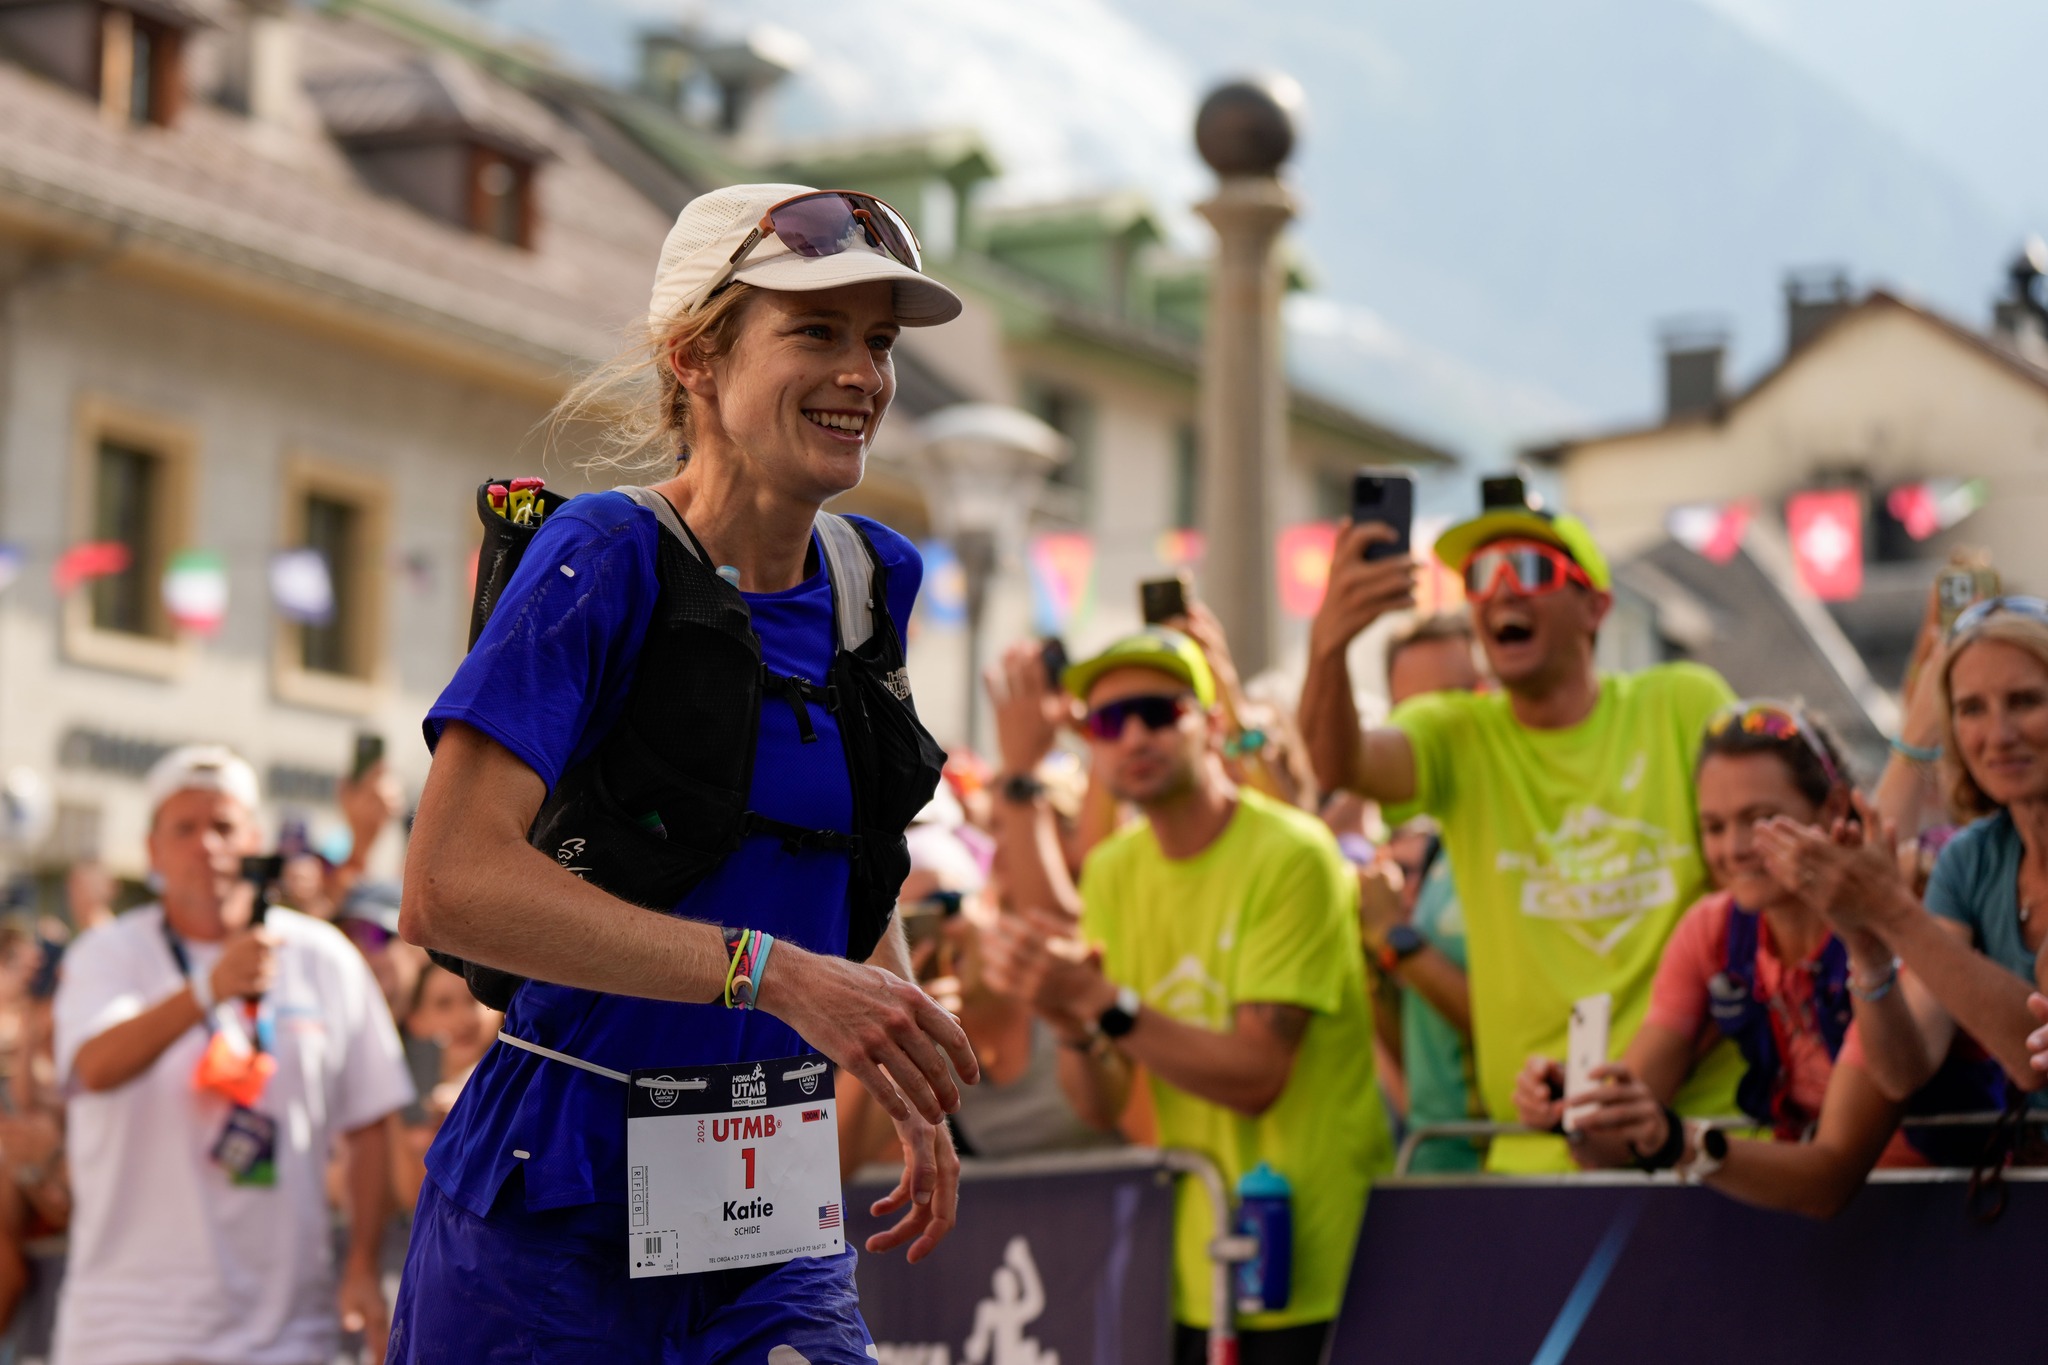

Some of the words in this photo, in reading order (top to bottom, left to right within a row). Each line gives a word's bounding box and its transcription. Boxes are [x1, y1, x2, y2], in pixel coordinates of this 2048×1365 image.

[732, 1074, 751, 1083] HOKA
[732, 1081, 767, 1098] UTMB
[820, 1108, 829, 1120] M
[697, 1119, 705, 1143] 2024
[741, 1147, 756, 1190] 1
[723, 1196, 774, 1222] Katie
[734, 1225, 761, 1236] SCHIDE
